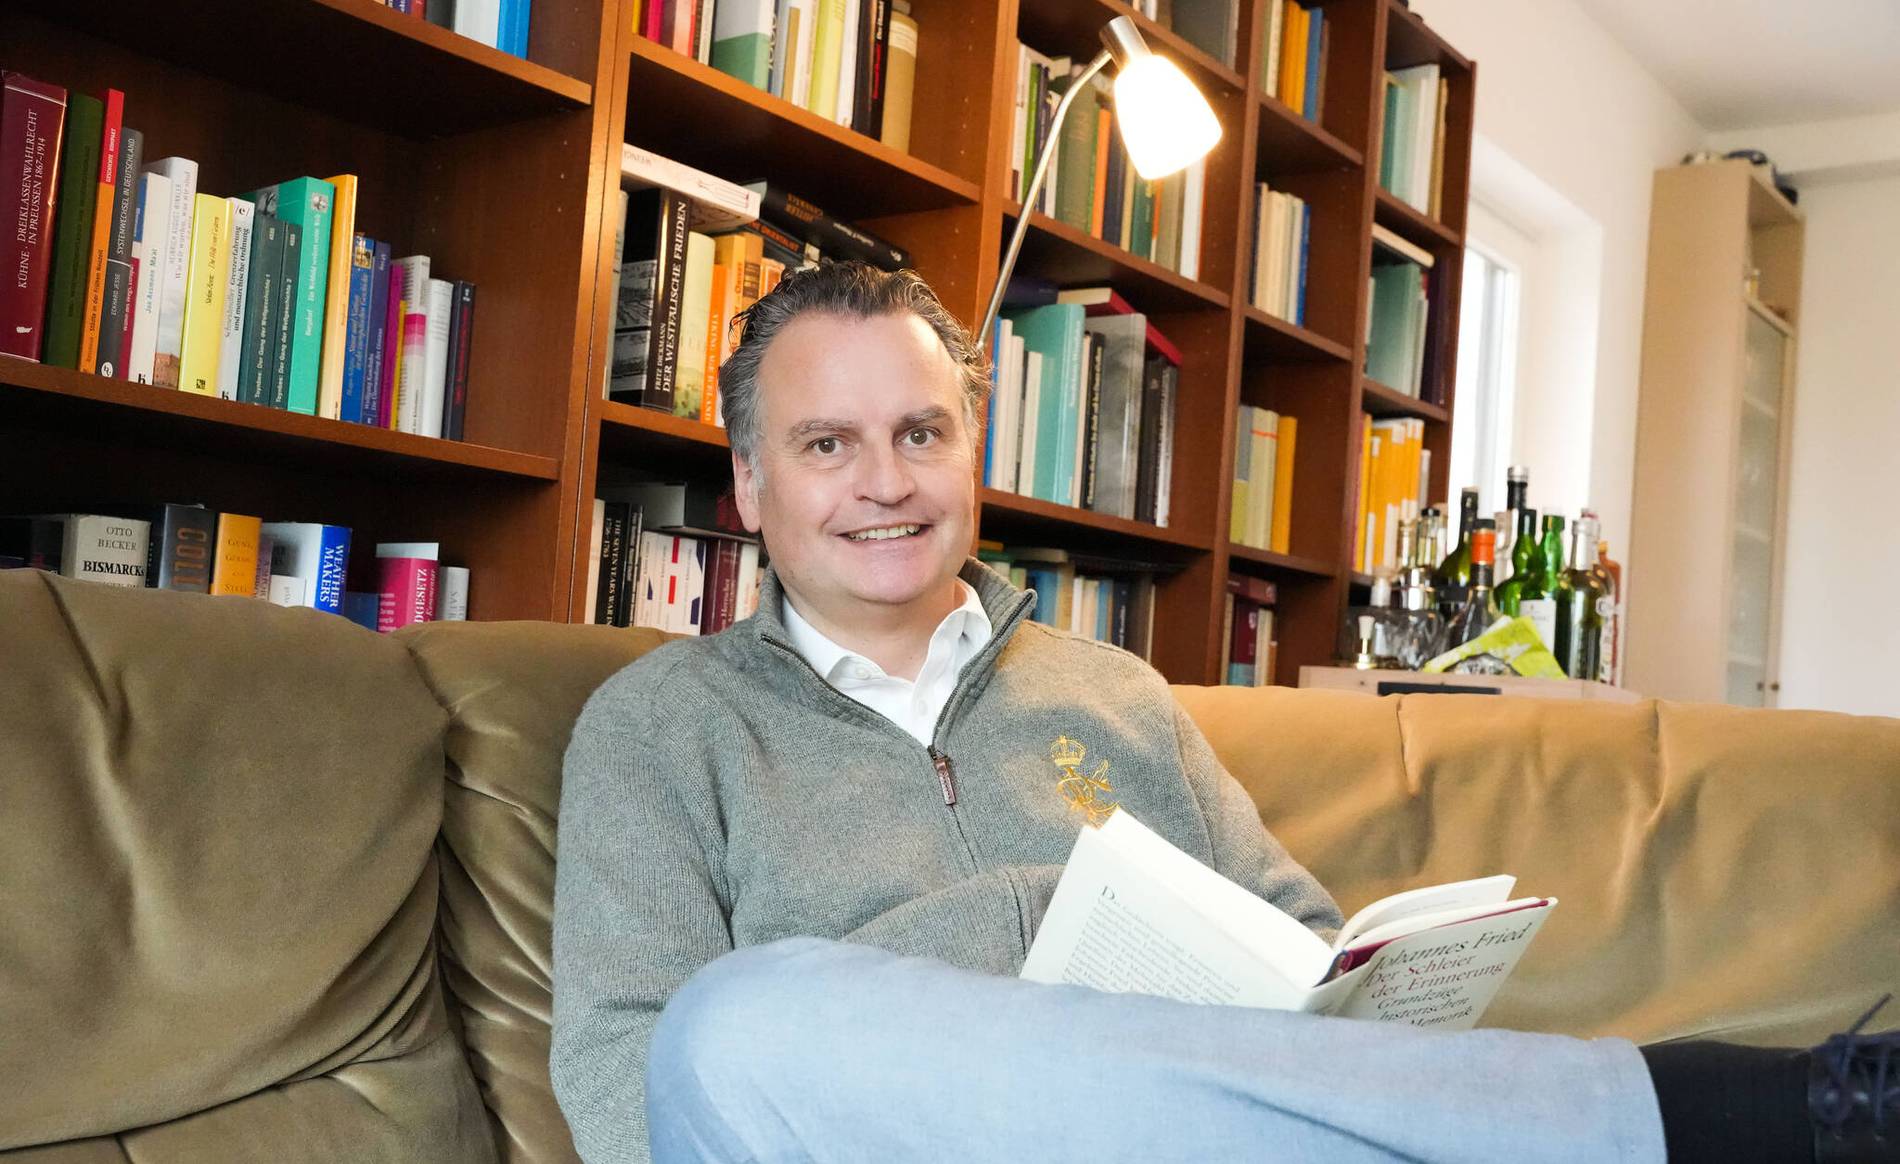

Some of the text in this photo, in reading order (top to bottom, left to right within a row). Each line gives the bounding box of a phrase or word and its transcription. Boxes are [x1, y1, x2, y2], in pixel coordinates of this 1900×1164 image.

[17, 109, 38, 288] KÜHNE DREIKLASSENWAHLRECHT
[29, 181, 42, 230] PREUSSEN
[116, 197, 129, 255] SYSTEMWECHSEL
[123, 138, 135, 187] DEUTSCHLAND
[27, 231, 37, 244] IN
[235, 262, 245, 315] monarchische
[240, 228, 249, 261] Ordnung
[662, 201, 687, 393] DER WESTFÄLISCHE FRIEDEN
[258, 339, 266, 355] Gang
[654, 322, 667, 392] FRITZ DICKMANN
[98, 539, 137, 551] BECKER
[106, 526, 133, 537] OTTO
[612, 537, 620, 565] SEVEN
[319, 547, 335, 603] MAKERS
[329, 544, 345, 608] WEATHER
[609, 566, 617, 594] YEARS
[1473, 922, 1532, 949] Fried
[1372, 963, 1505, 999] der Erinnerung
[1404, 954, 1477, 977] Schleier
